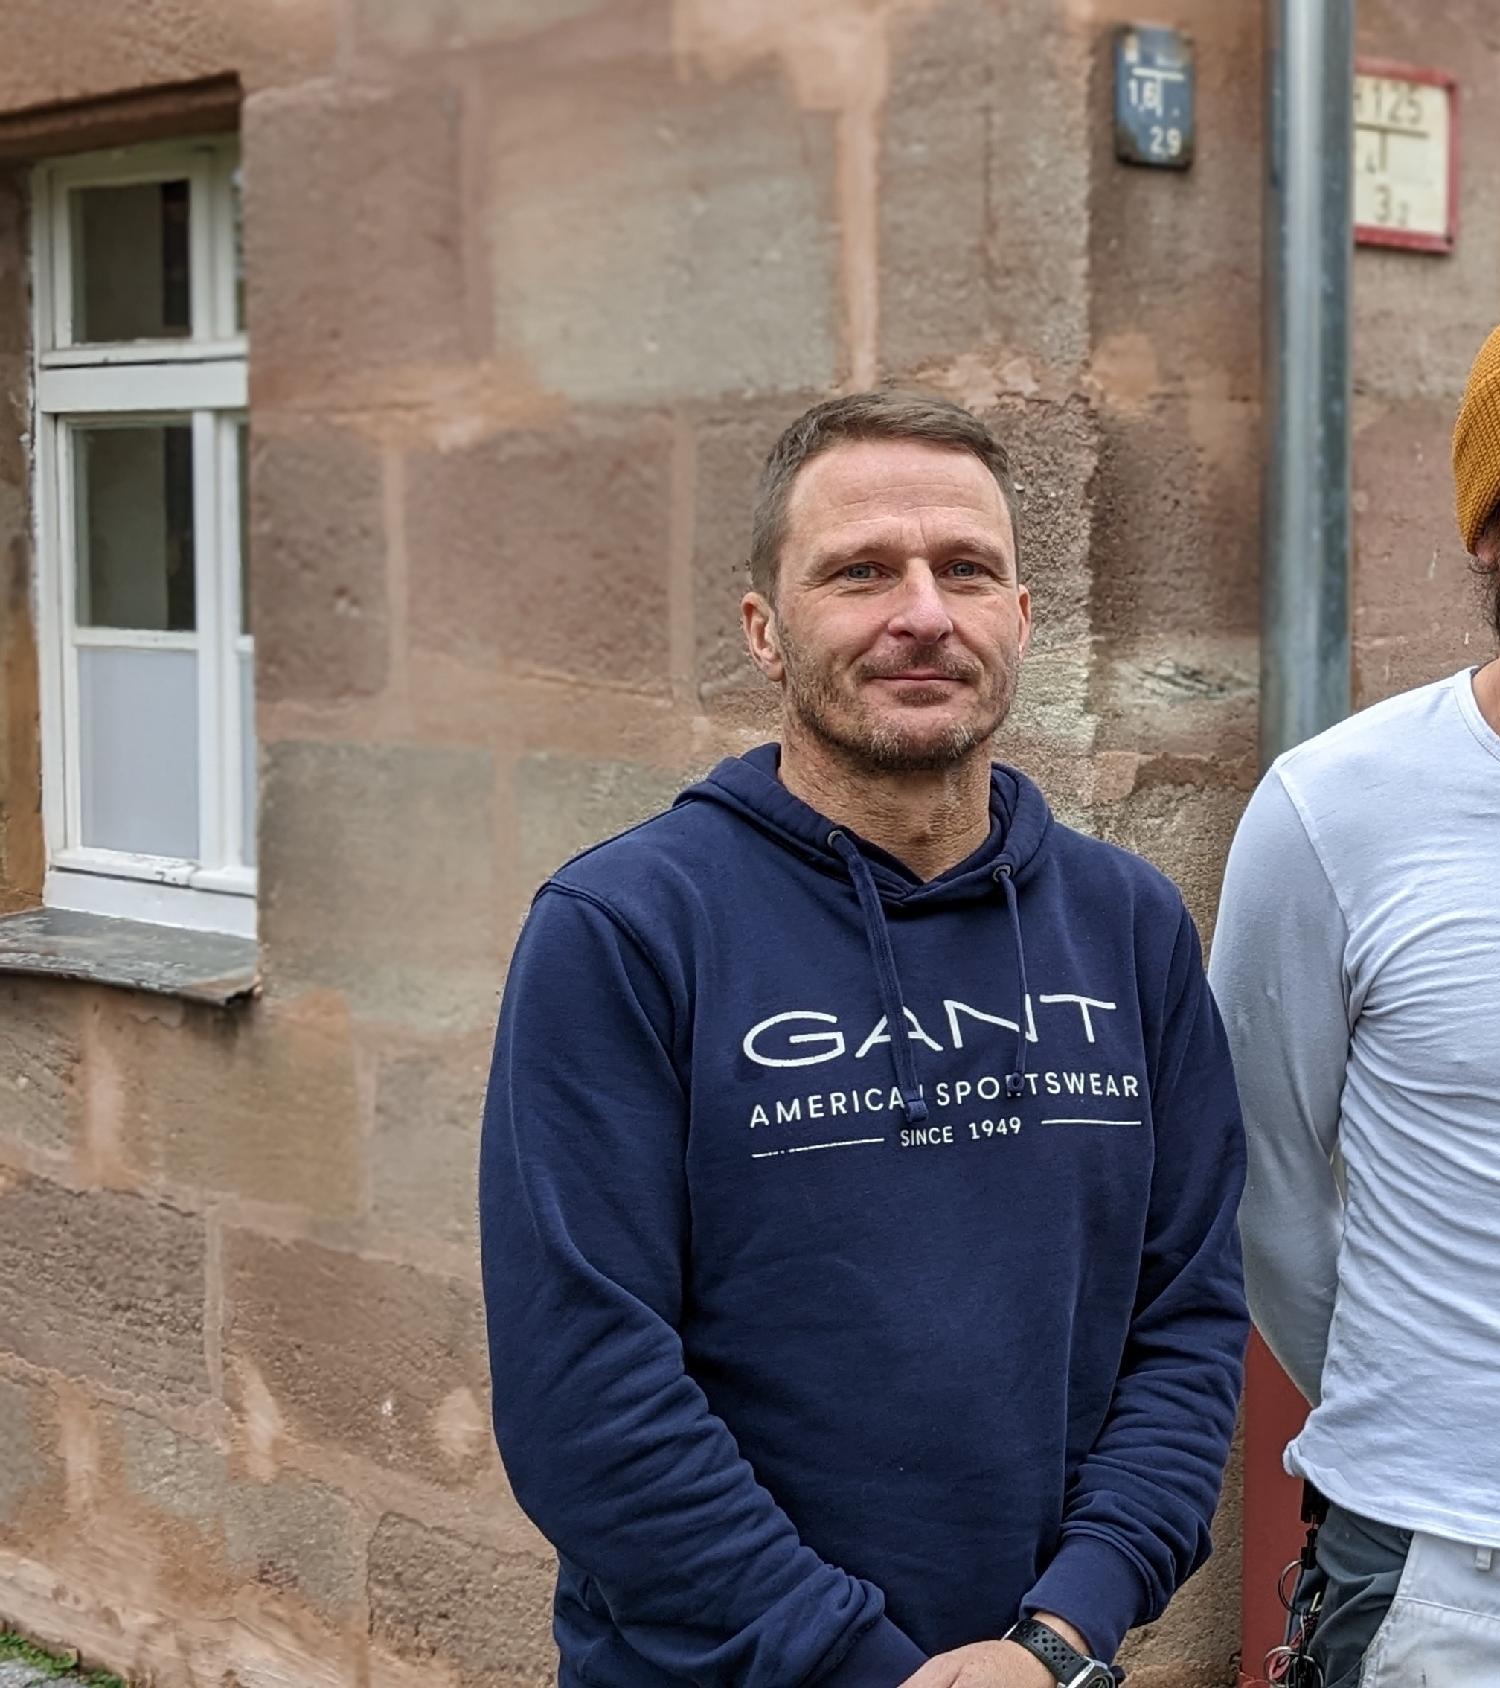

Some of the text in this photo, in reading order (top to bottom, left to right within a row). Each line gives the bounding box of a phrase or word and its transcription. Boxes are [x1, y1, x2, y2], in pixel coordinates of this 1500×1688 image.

[742, 993, 1117, 1069] GANT
[899, 1116, 1022, 1147] SINCE 1949
